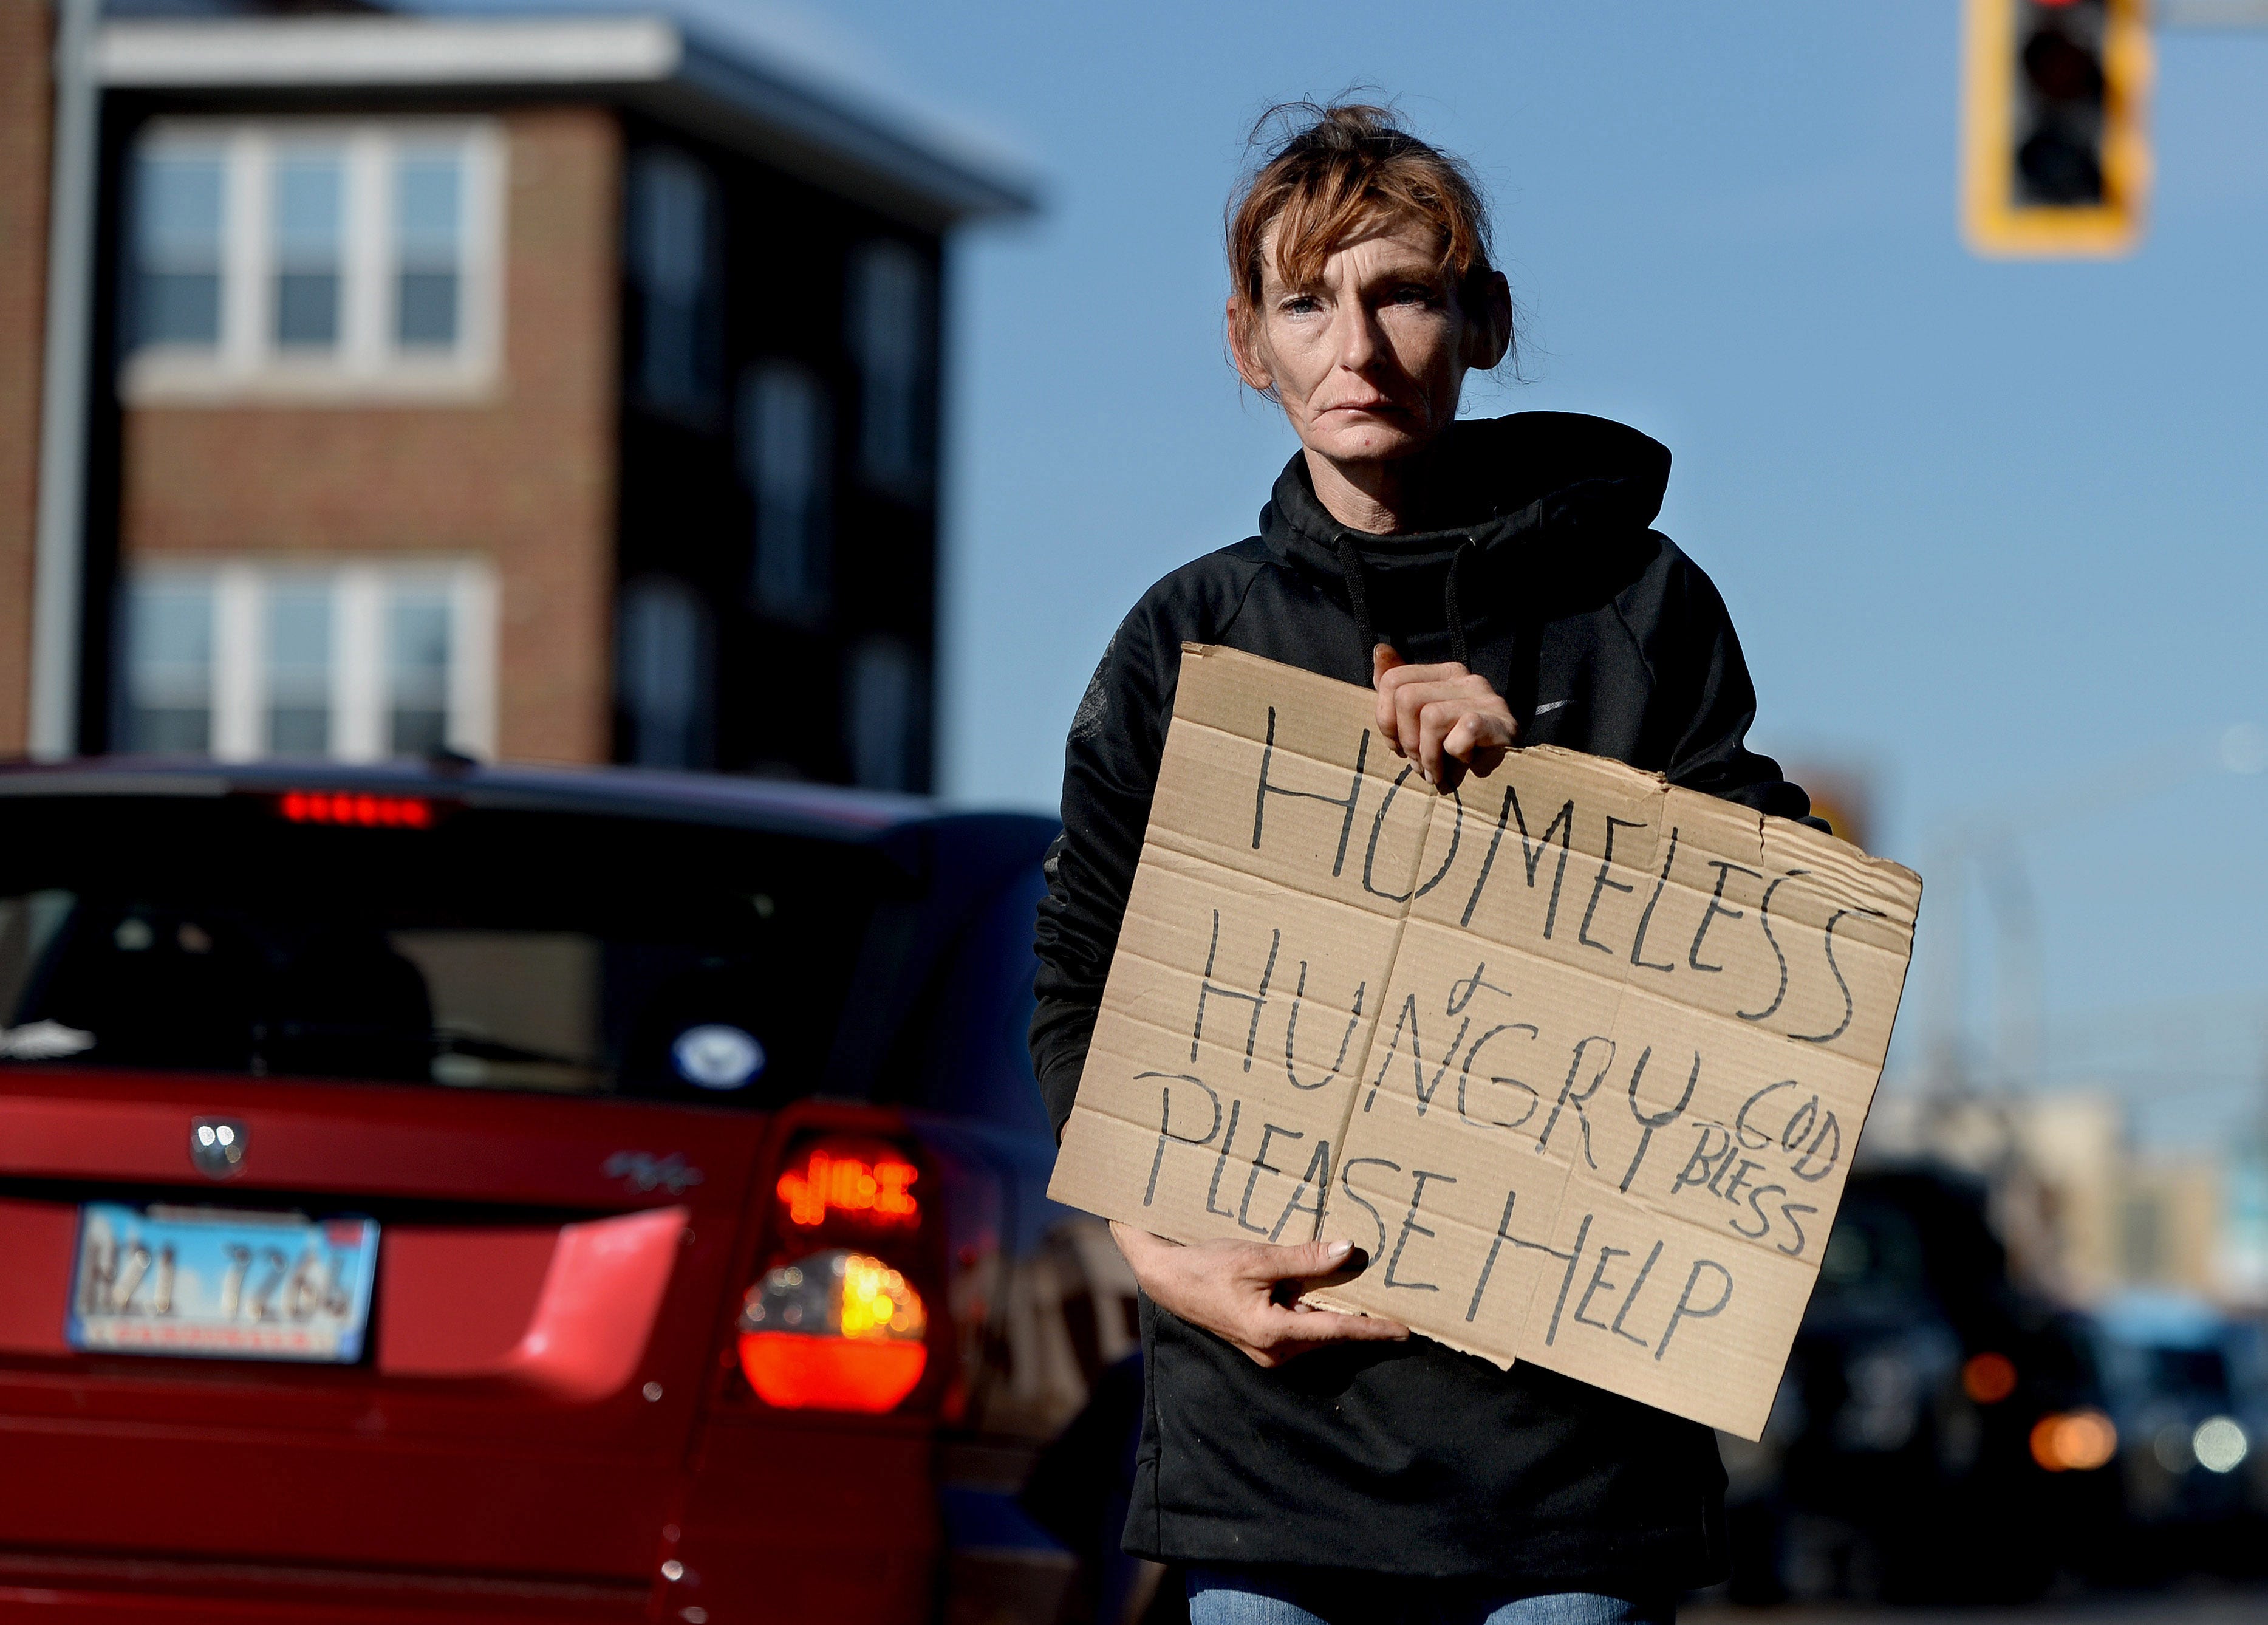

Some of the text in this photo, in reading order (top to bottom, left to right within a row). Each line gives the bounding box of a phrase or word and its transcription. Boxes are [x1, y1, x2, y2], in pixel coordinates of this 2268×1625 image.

[1252, 706, 1883, 1042] HOMELESS
[1190, 909, 1701, 1194] HUNGRY
[1670, 1121, 1819, 1256] BLESS
[1735, 1080, 1840, 1182] GOD
[1133, 1072, 1733, 1360] PLEASE HELP
